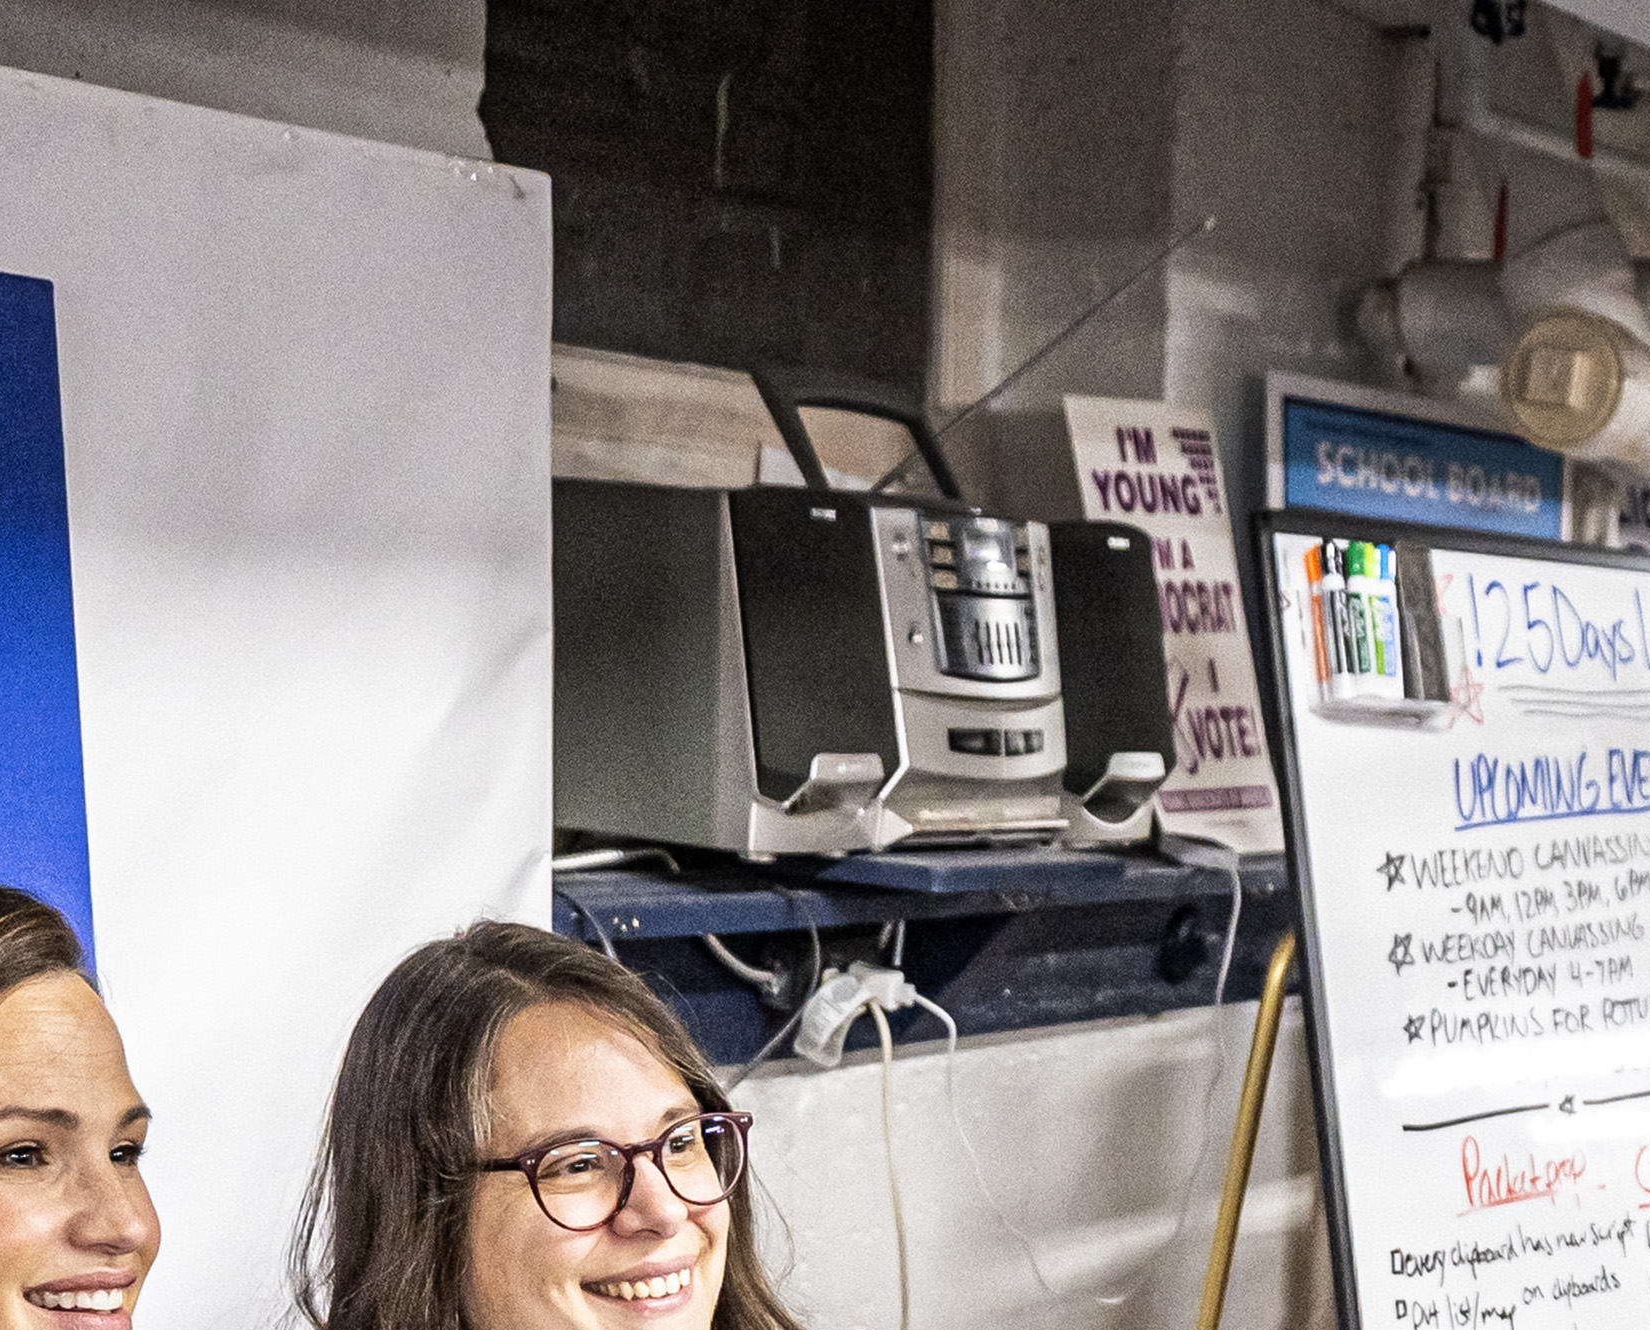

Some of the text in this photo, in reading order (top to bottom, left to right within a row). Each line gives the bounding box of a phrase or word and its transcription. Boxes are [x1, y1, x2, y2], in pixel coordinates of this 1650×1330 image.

[1116, 426, 1157, 464] I'M
[1091, 468, 1202, 515] YOUNG
[1314, 440, 1542, 513] SCHOOL BOARD
[1159, 580, 1238, 635] OCRAT
[1552, 584, 1637, 681] Days
[1454, 749, 1601, 821] UPCOMING
[1410, 846, 1526, 890] WEEKEND
[1422, 912, 1647, 965] WEEKDAY CANVASSING
[1429, 1007, 1545, 1048] PUMPKINS
[1553, 1006, 1590, 1036] FOR
[1522, 1285, 1544, 1305] on
